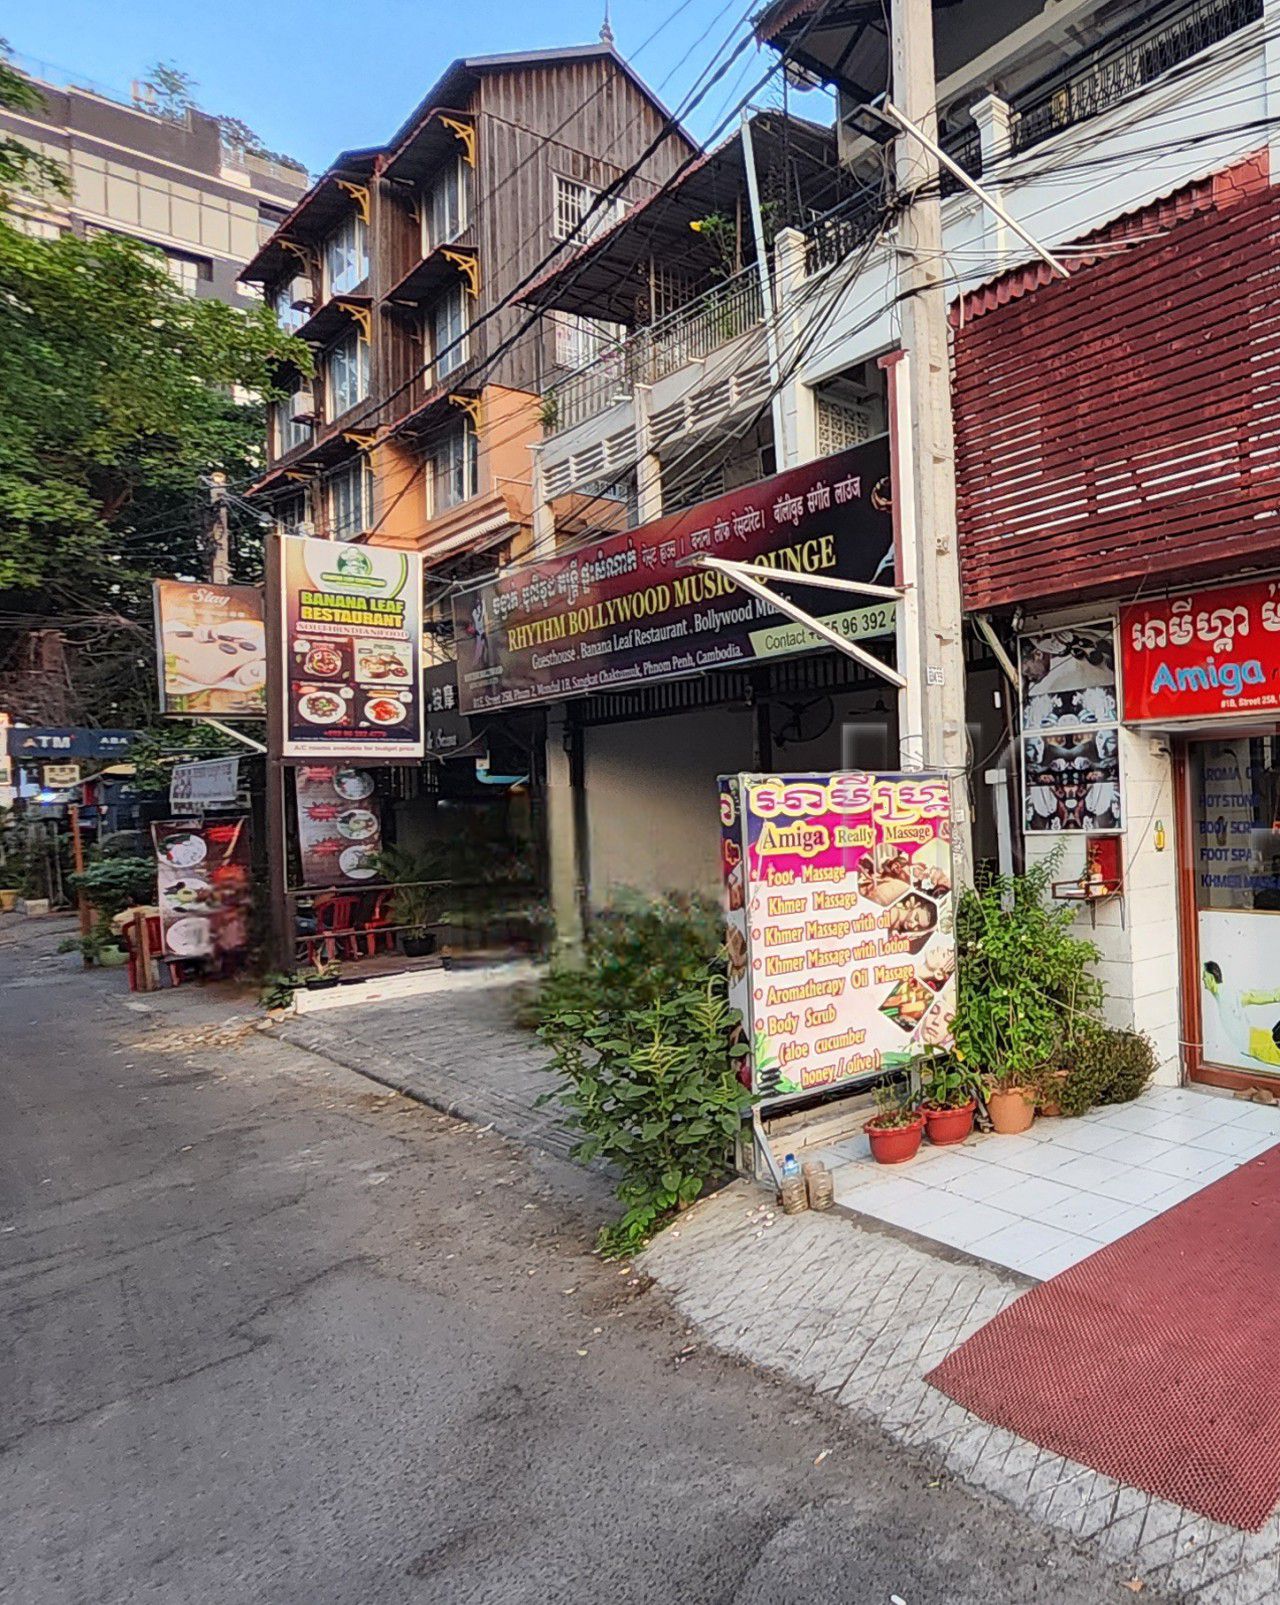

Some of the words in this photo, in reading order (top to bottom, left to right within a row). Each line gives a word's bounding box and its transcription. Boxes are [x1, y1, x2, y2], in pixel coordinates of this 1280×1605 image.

[300, 591, 368, 611] BANANA
[369, 598, 405, 613] LEAF
[508, 613, 566, 652] RHYTHM
[569, 585, 671, 636] BOLLYWOOD
[673, 568, 738, 608] MUSIC
[743, 534, 837, 586] OUNGE
[300, 606, 404, 628] RESTAURANT
[532, 648, 576, 670] Guesthouse
[580, 639, 612, 661] Banana
[613, 629, 634, 652] Leaf
[634, 619, 688, 647] Restaurant
[694, 600, 753, 634] Bollywood
[756, 593, 792, 618] Muic
[765, 628, 807, 650] Contact
[842, 616, 858, 636] 96
[862, 611, 887, 632] 392
[643, 660, 672, 676] Phnom
[672, 653, 696, 670] Penh,
[696, 643, 743, 664] Cambodia.
[1151, 656, 1267, 697] Amiga
[1238, 697, 1262, 707] Street
[22, 735, 71, 749] ATM
[100, 736, 129, 745] ABA
[762, 825, 826, 853] Amiga
[837, 826, 875, 847] Really
[885, 826, 932, 842] Massage
[1201, 848, 1230, 861] FOOT
[767, 867, 795, 887] Foot
[802, 865, 846, 885] Massage
[768, 896, 808, 917] Khmer
[812, 891, 858, 911] Massage
[764, 925, 804, 947] Khmer
[806, 919, 851, 941] Massage
[852, 914, 876, 934] with
[877, 911, 892, 930] oil
[765, 955, 804, 976] Khmer
[806, 949, 851, 969] Massage
[853, 943, 877, 962] with
[878, 937, 910, 956] Lotion
[765, 977, 846, 1006] Aromatherapy
[851, 969, 869, 988] Oil
[874, 963, 915, 985] Massage
[767, 1012, 800, 1037] Body
[804, 1004, 837, 1028] Scrub
[778, 1040, 808, 1067] (aloe
[814, 1028, 866, 1054] cucumber
[800, 1063, 836, 1089] honey
[846, 1054, 873, 1076] olive
